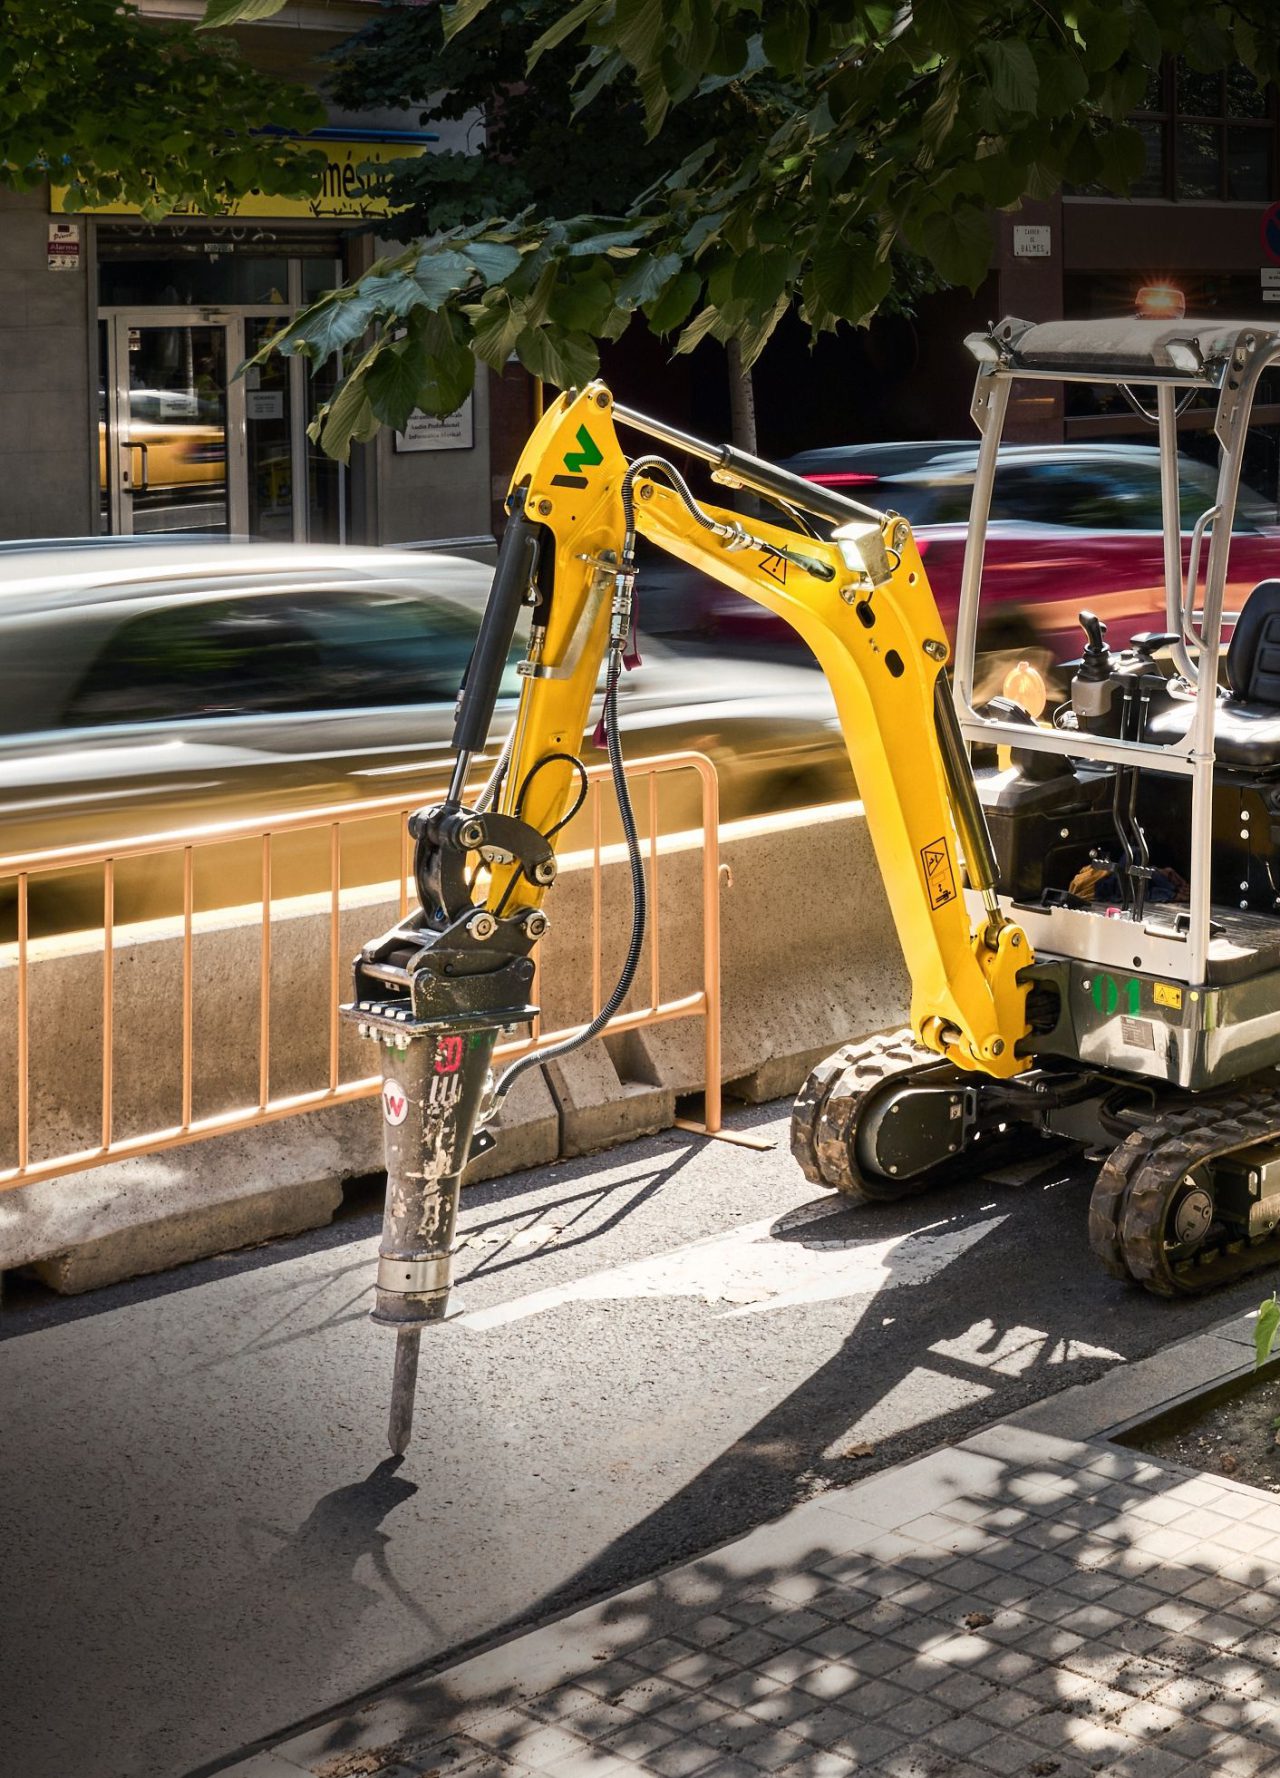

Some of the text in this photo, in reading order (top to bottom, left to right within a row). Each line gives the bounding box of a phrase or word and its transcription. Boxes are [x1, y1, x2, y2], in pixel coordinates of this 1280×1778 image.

[50, 243, 78, 251] Alarma
[1020, 244, 1045, 252] BALMES
[1091, 974, 1142, 1018] 01
